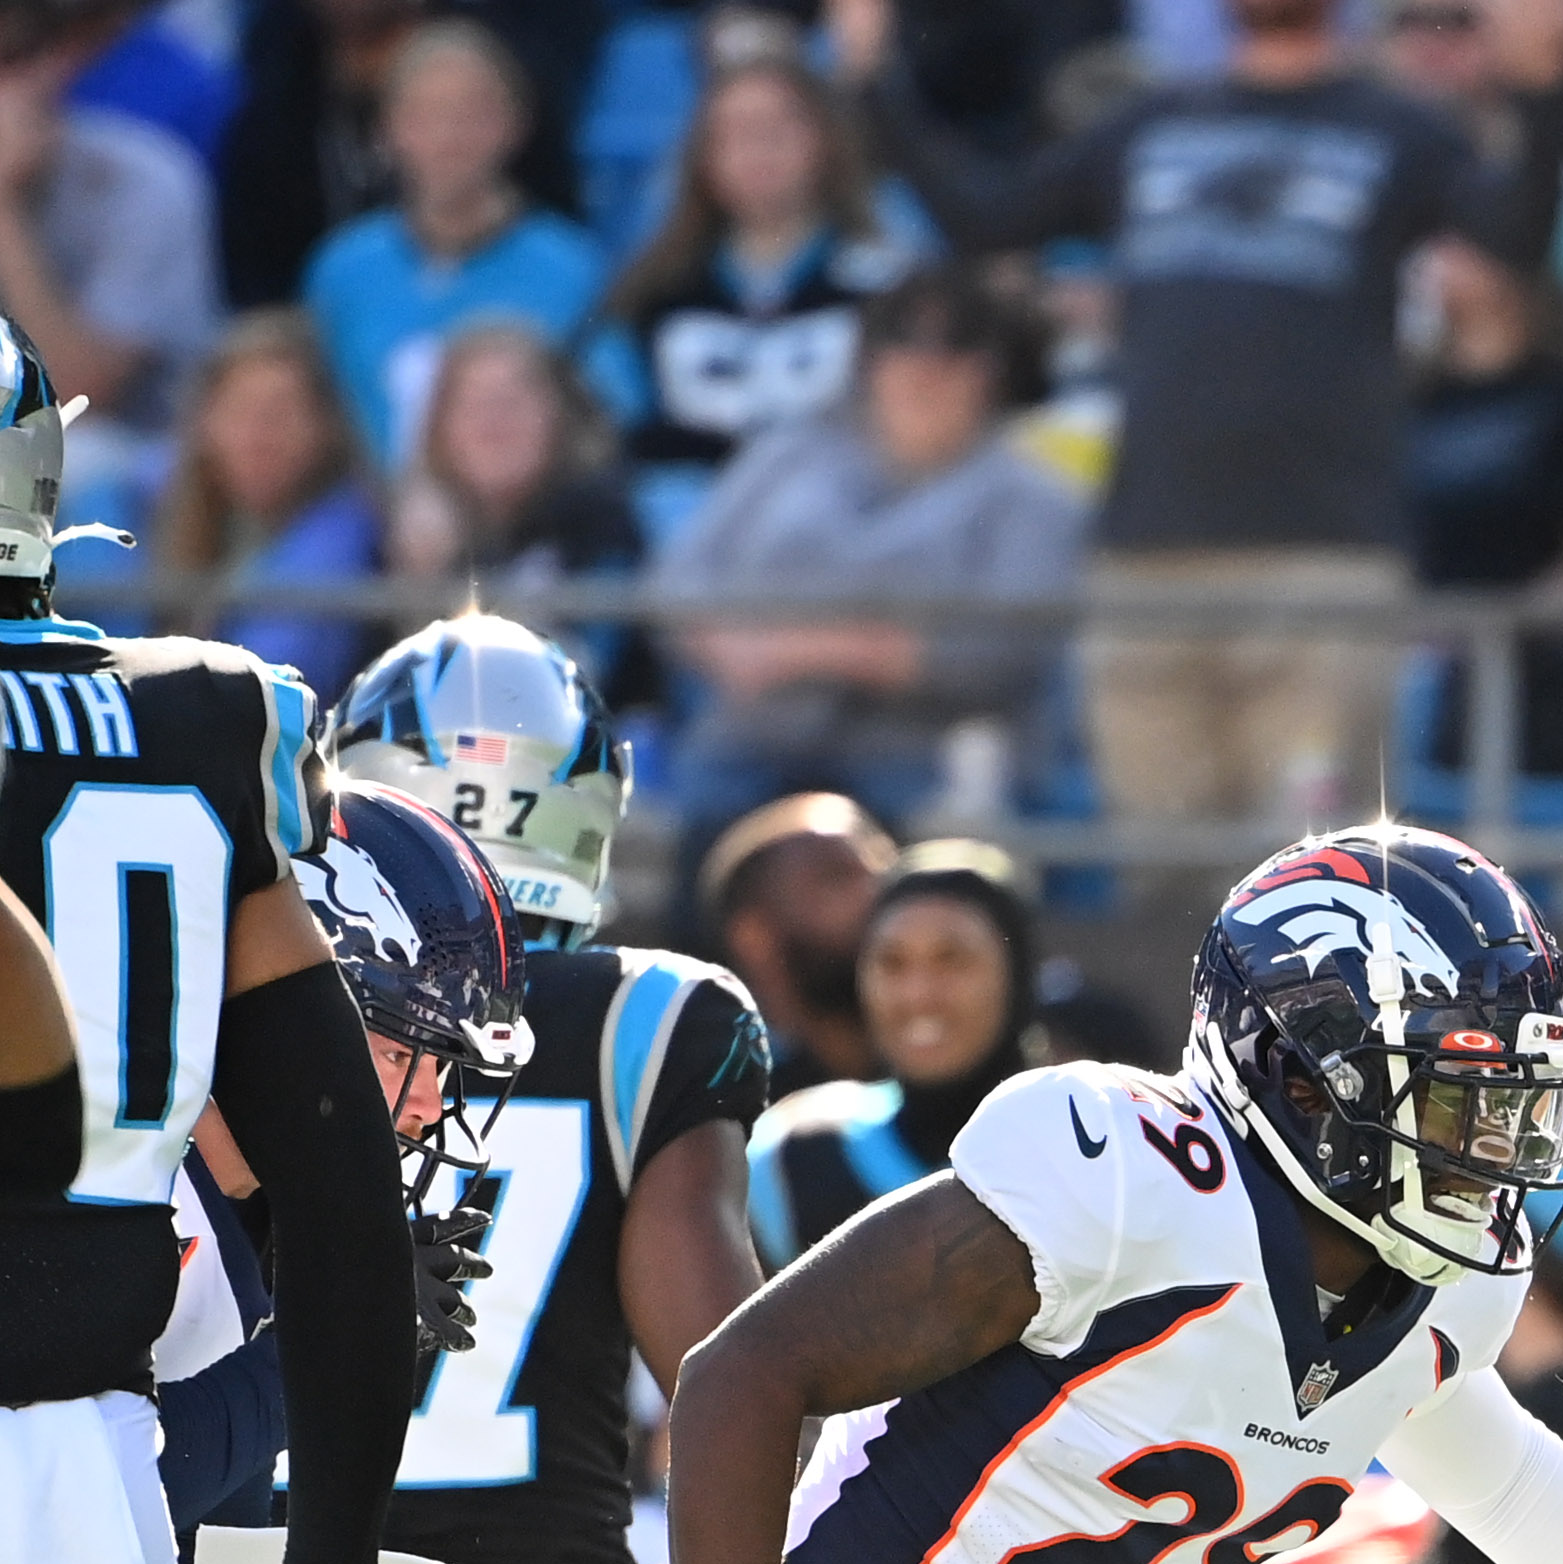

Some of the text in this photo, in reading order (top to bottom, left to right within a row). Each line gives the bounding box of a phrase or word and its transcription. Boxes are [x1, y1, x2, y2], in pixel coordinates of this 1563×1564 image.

[454, 782, 538, 838] 27
[273, 1096, 592, 1491] 7
[1243, 1422, 1330, 1455] BRONCOS
